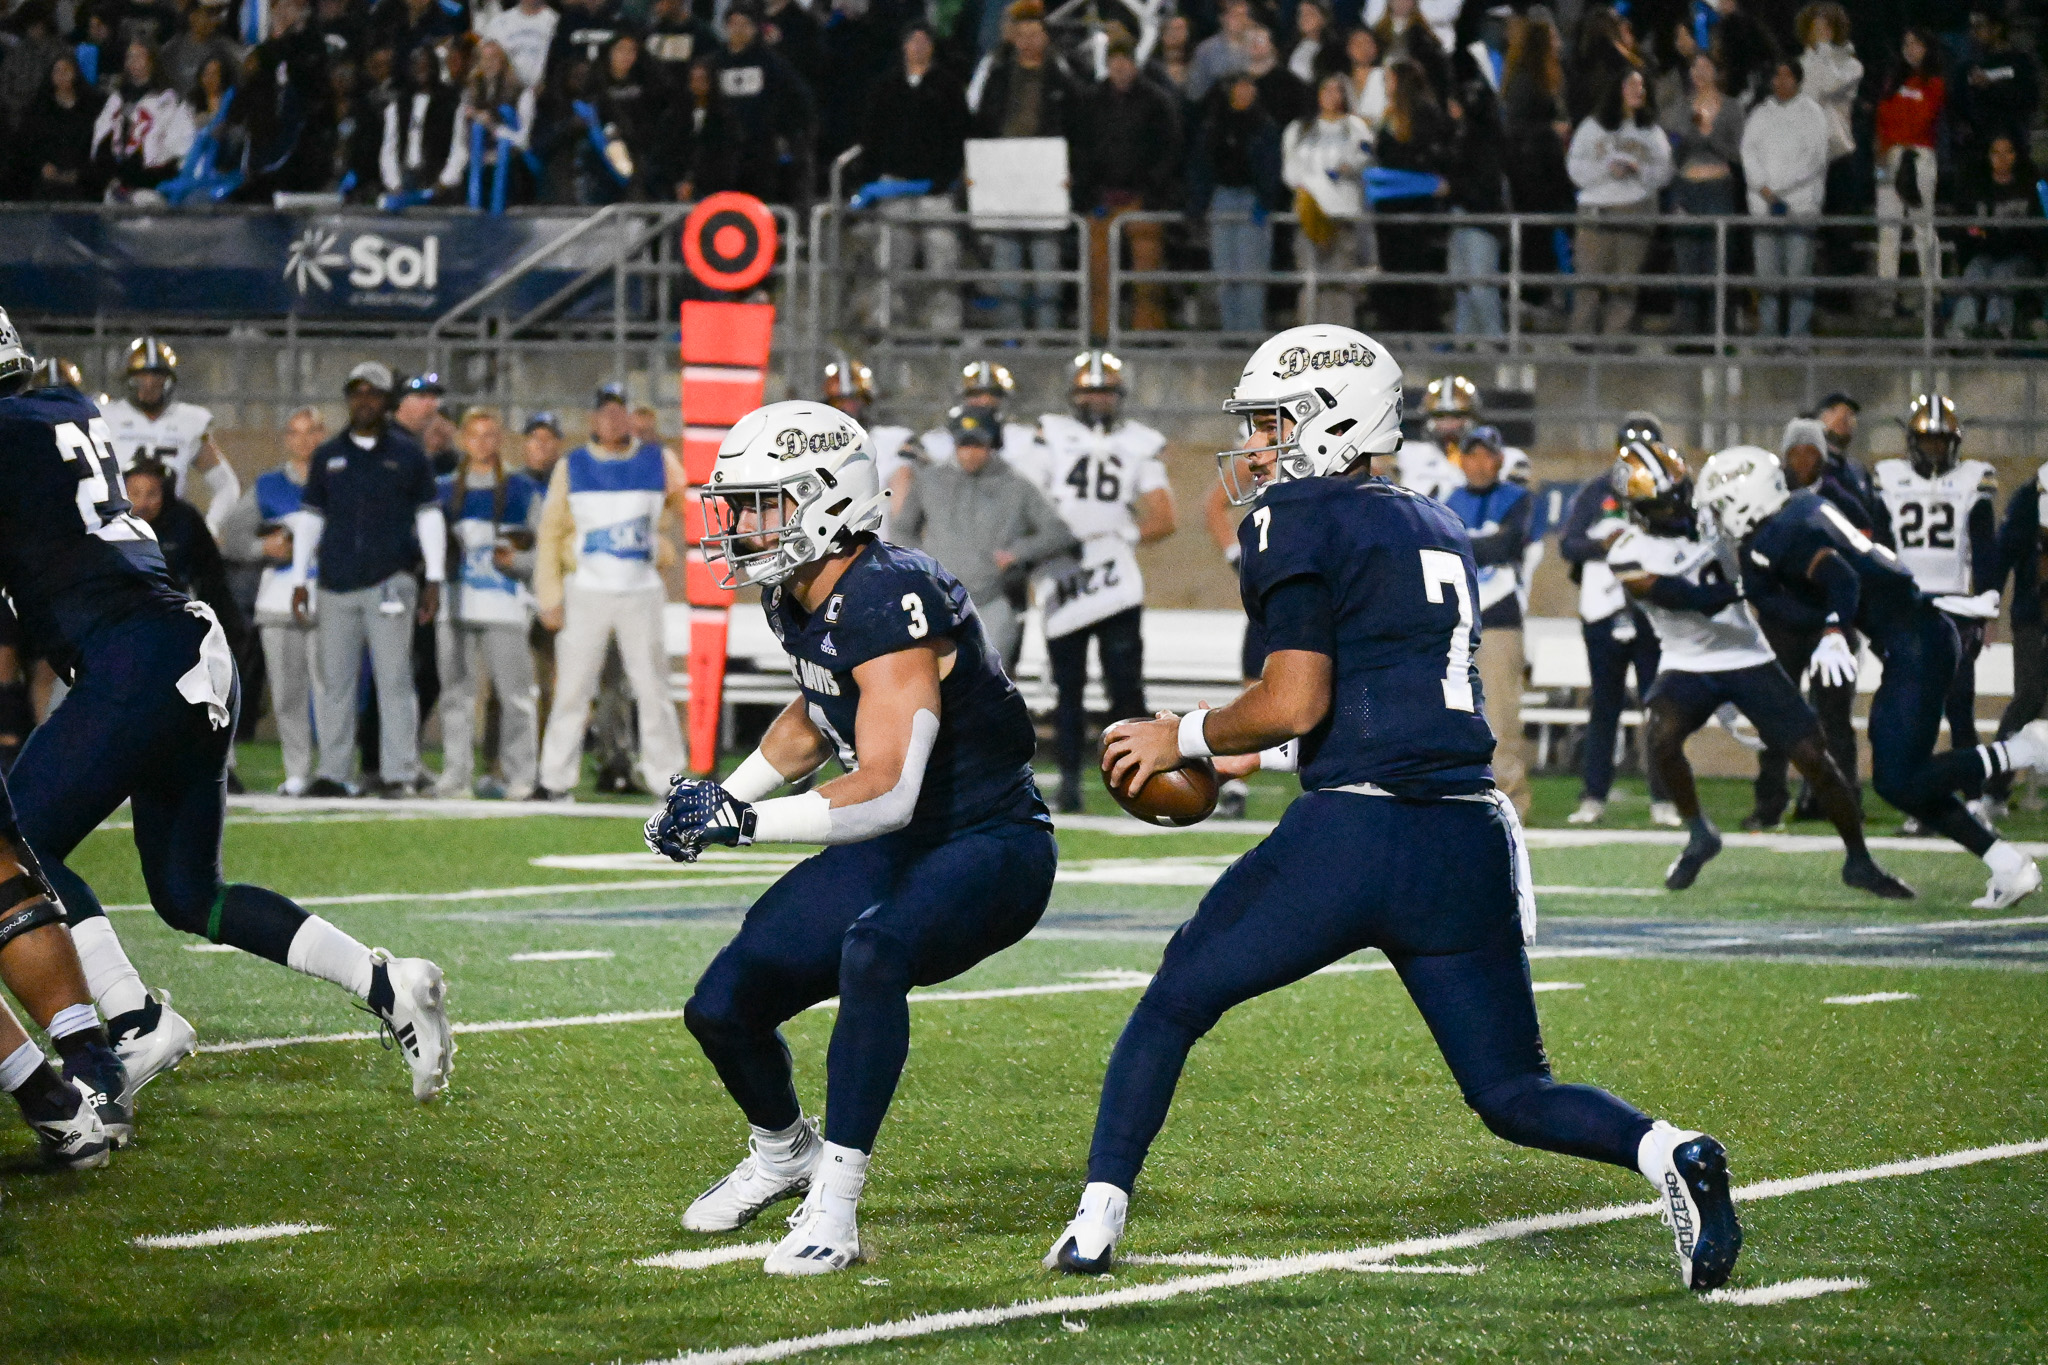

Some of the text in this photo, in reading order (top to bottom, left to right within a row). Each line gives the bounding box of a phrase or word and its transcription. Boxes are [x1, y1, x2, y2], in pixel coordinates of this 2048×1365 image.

[349, 234, 438, 289] Sol
[1279, 343, 1376, 380] Davis
[1066, 454, 1121, 501] 46
[1253, 505, 1271, 552] 7
[1900, 502, 1955, 549] 22
[901, 592, 929, 640] 3
[1419, 549, 1475, 713] 7
[800, 657, 841, 696] DAVIS
